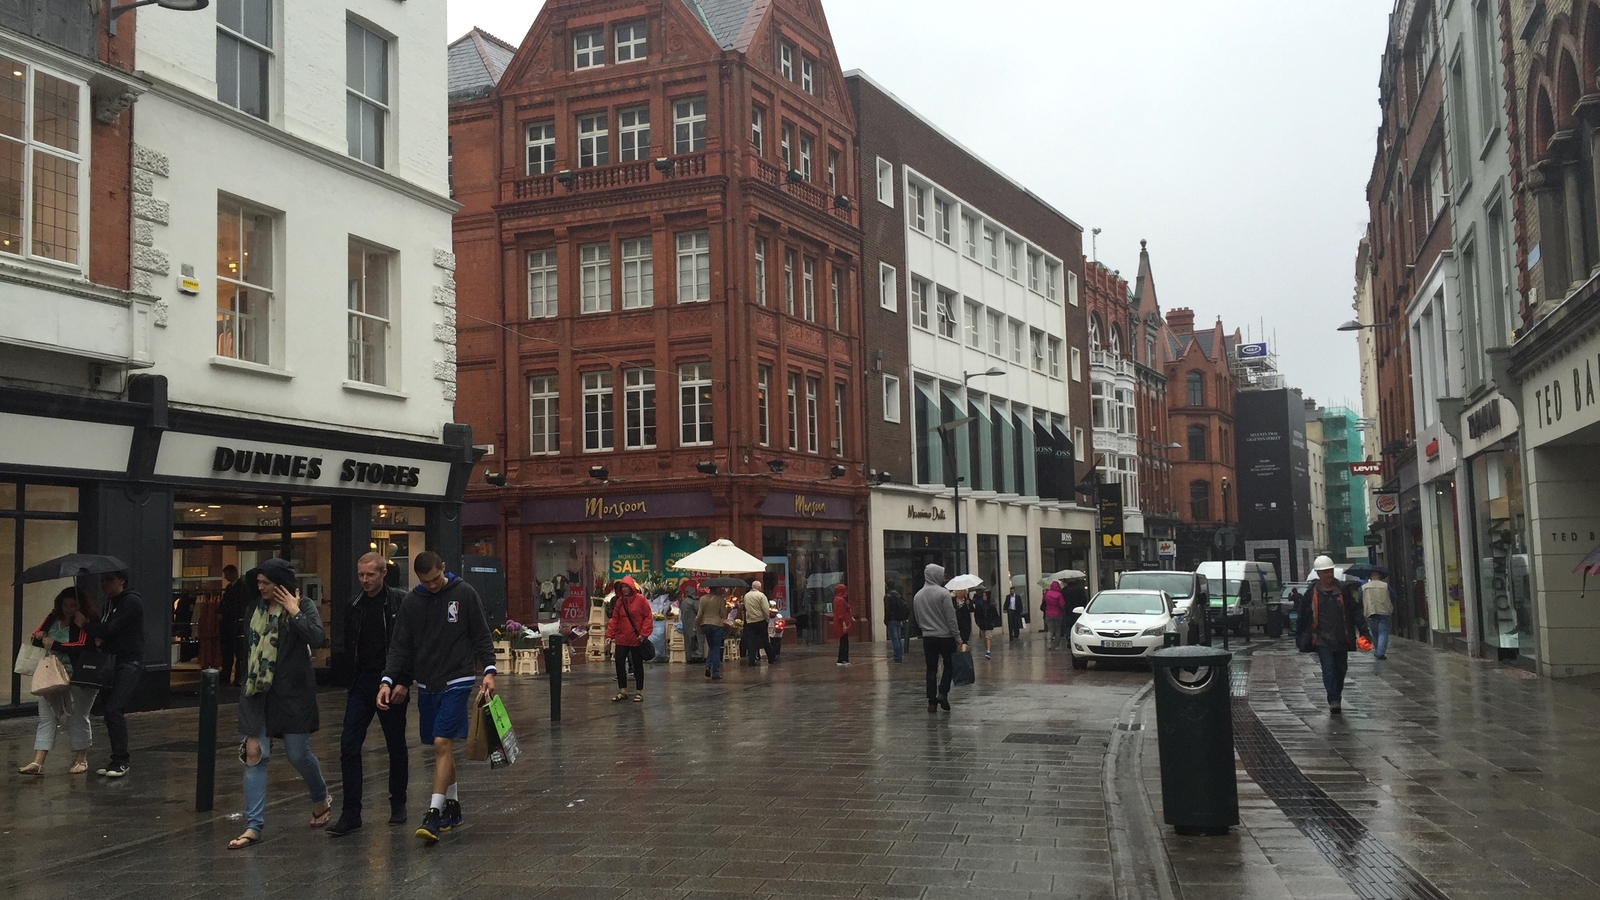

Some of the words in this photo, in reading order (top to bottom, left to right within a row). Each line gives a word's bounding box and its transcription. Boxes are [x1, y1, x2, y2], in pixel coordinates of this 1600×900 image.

[1535, 380, 1562, 429] TED
[1573, 353, 1600, 412] BA
[213, 446, 323, 480] DUNNES
[340, 458, 420, 487] STORES
[585, 497, 647, 519] Monsoon
[795, 494, 826, 517] Monsoon
[1552, 532, 1578, 542] TED
[612, 560, 650, 574] SALE
